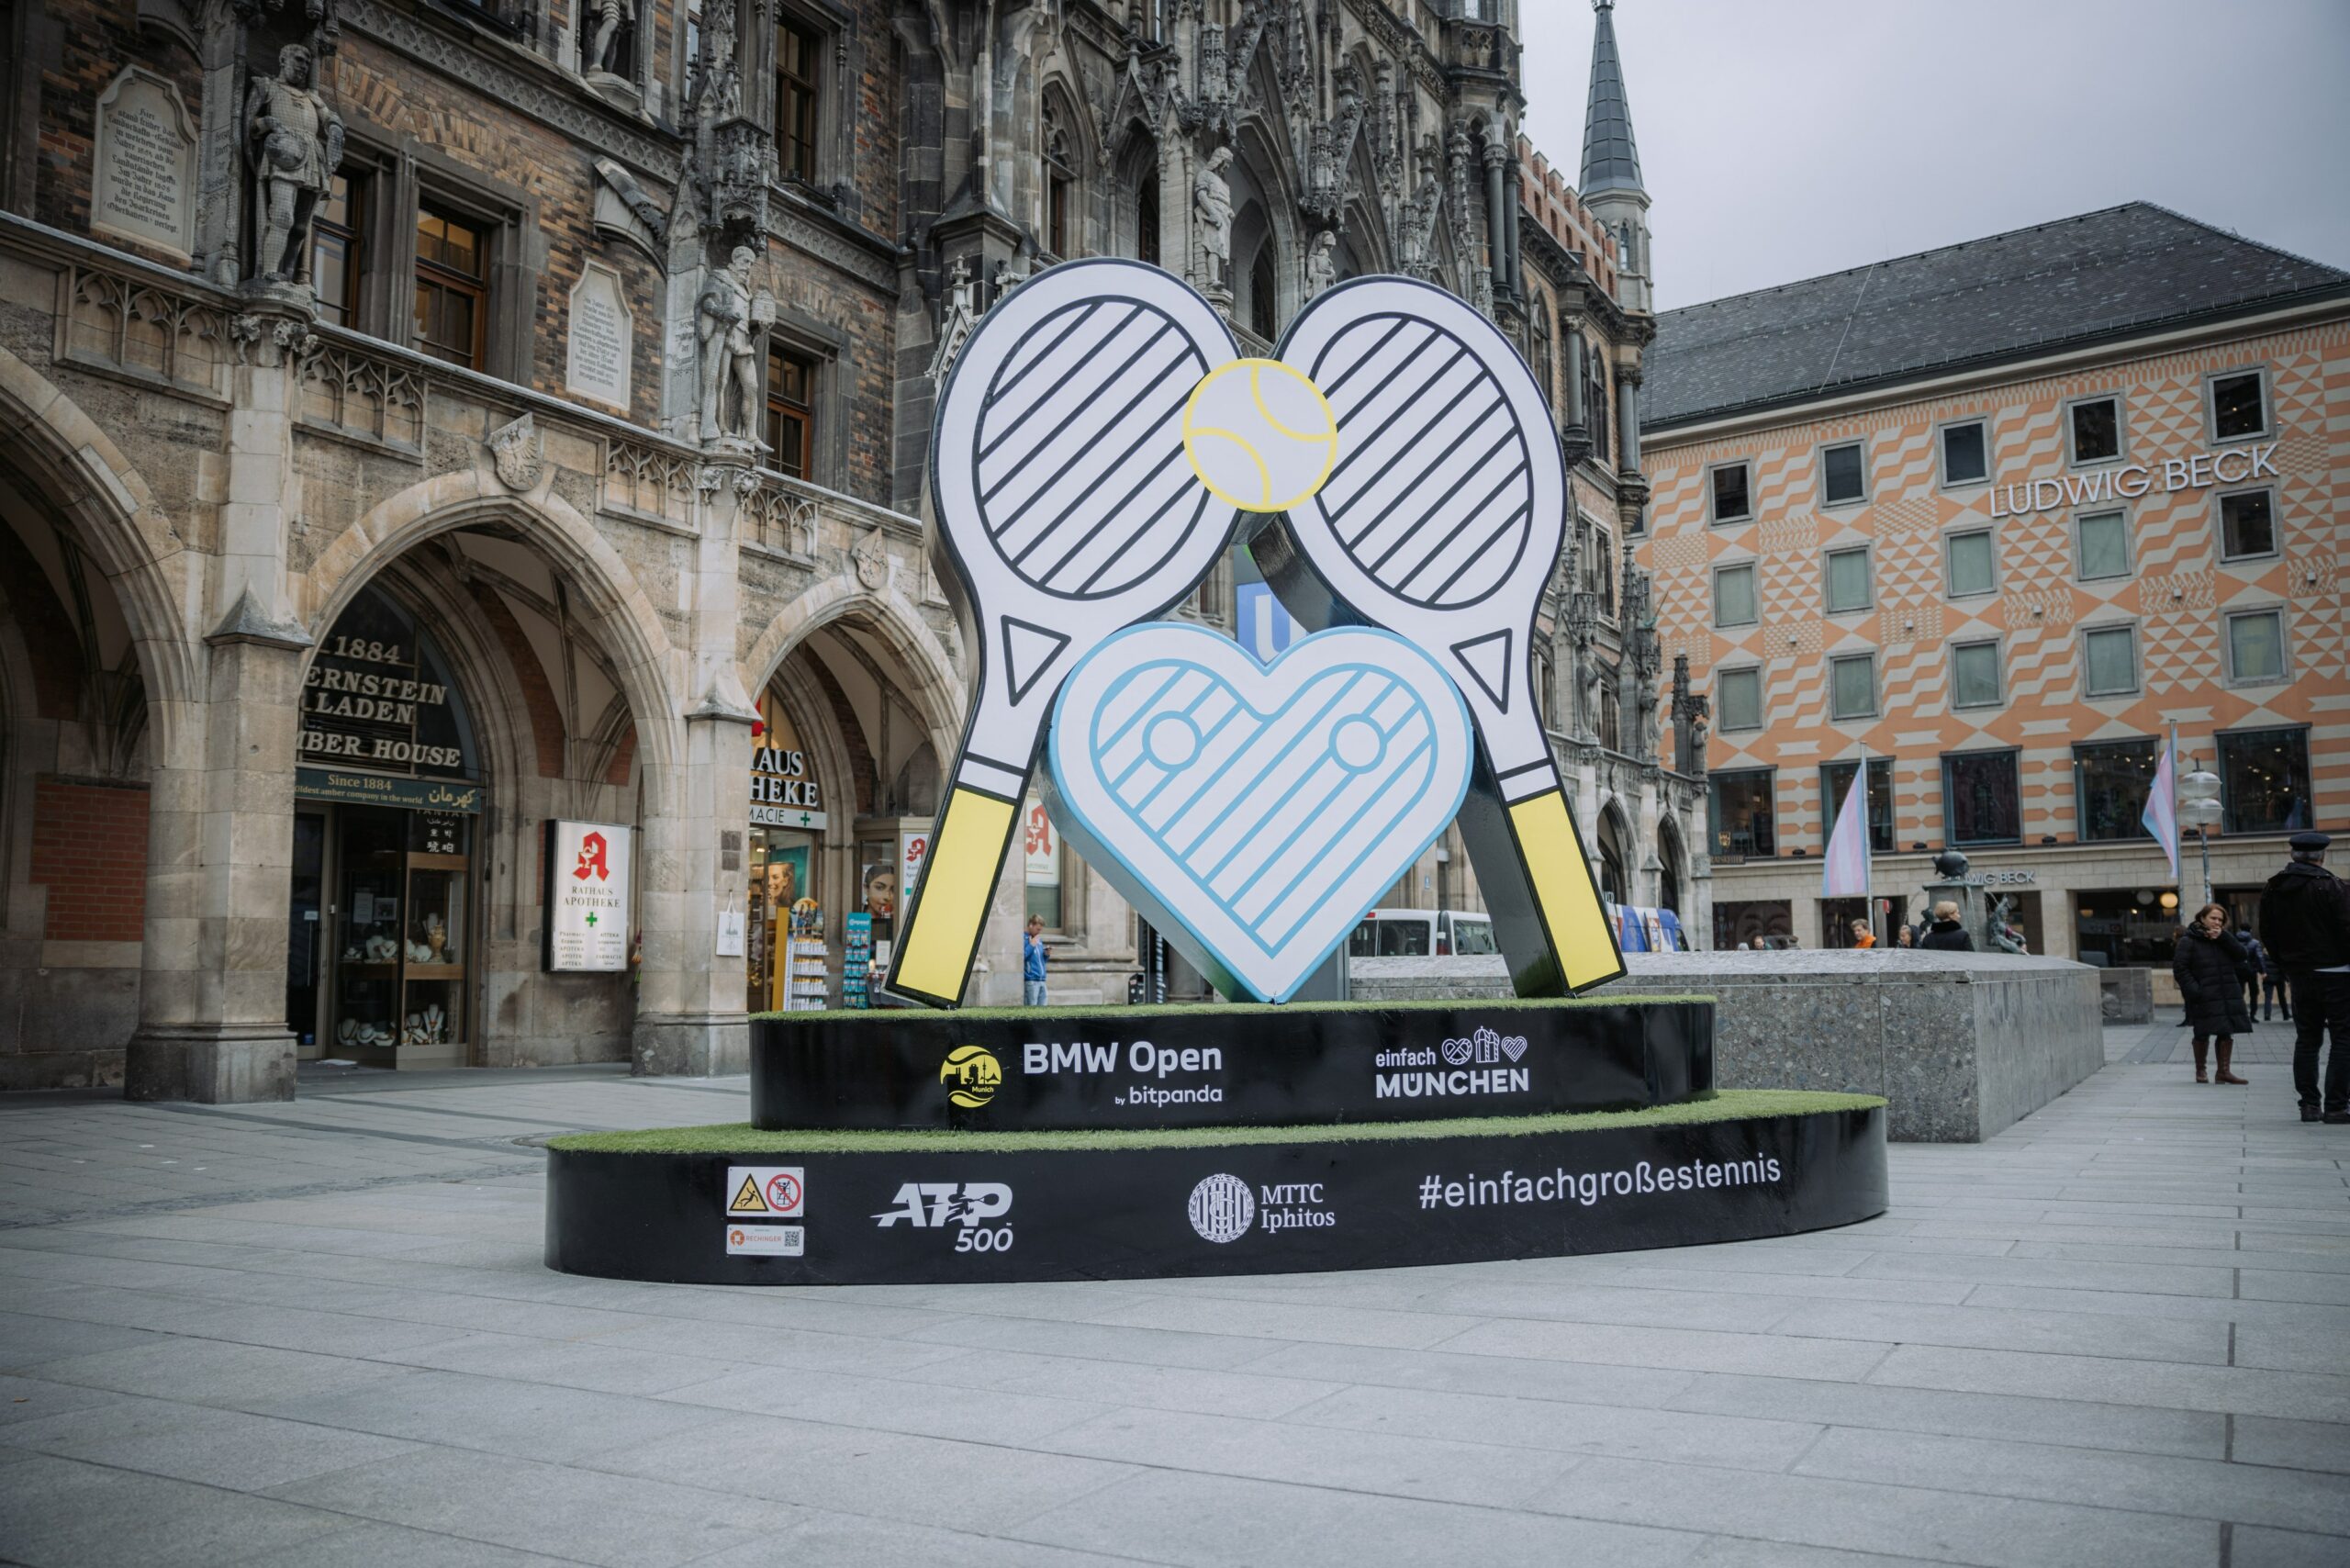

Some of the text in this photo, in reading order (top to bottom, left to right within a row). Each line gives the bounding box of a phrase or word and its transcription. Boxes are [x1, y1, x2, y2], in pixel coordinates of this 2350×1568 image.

[1990, 442, 2280, 518] LUDWIG BECK
[334, 636, 400, 664] 1884
[315, 692, 414, 724] LADEN
[373, 739, 461, 767] HOUSE
[328, 774, 392, 791] Since 1884
[321, 788, 345, 797] amber
[346, 791, 380, 801] company
[402, 797, 423, 805] world
[1999, 870, 2035, 885] BECK
[564, 897, 621, 908] APOTHEKE
[572, 886, 613, 896] RATHAUS
[1024, 1041, 1223, 1079] BMW Open
[1375, 1047, 1437, 1068] einfach
[1115, 1085, 1223, 1108] by bitpanda
[1376, 1068, 1529, 1099] MÜNCHEN
[1260, 1183, 1324, 1205] MTTC
[1418, 1153, 1782, 1209] #einfachgroßestennis
[869, 1182, 1013, 1227] ATP
[1260, 1207, 1336, 1234] Iphitos
[955, 1228, 1013, 1253] 500
